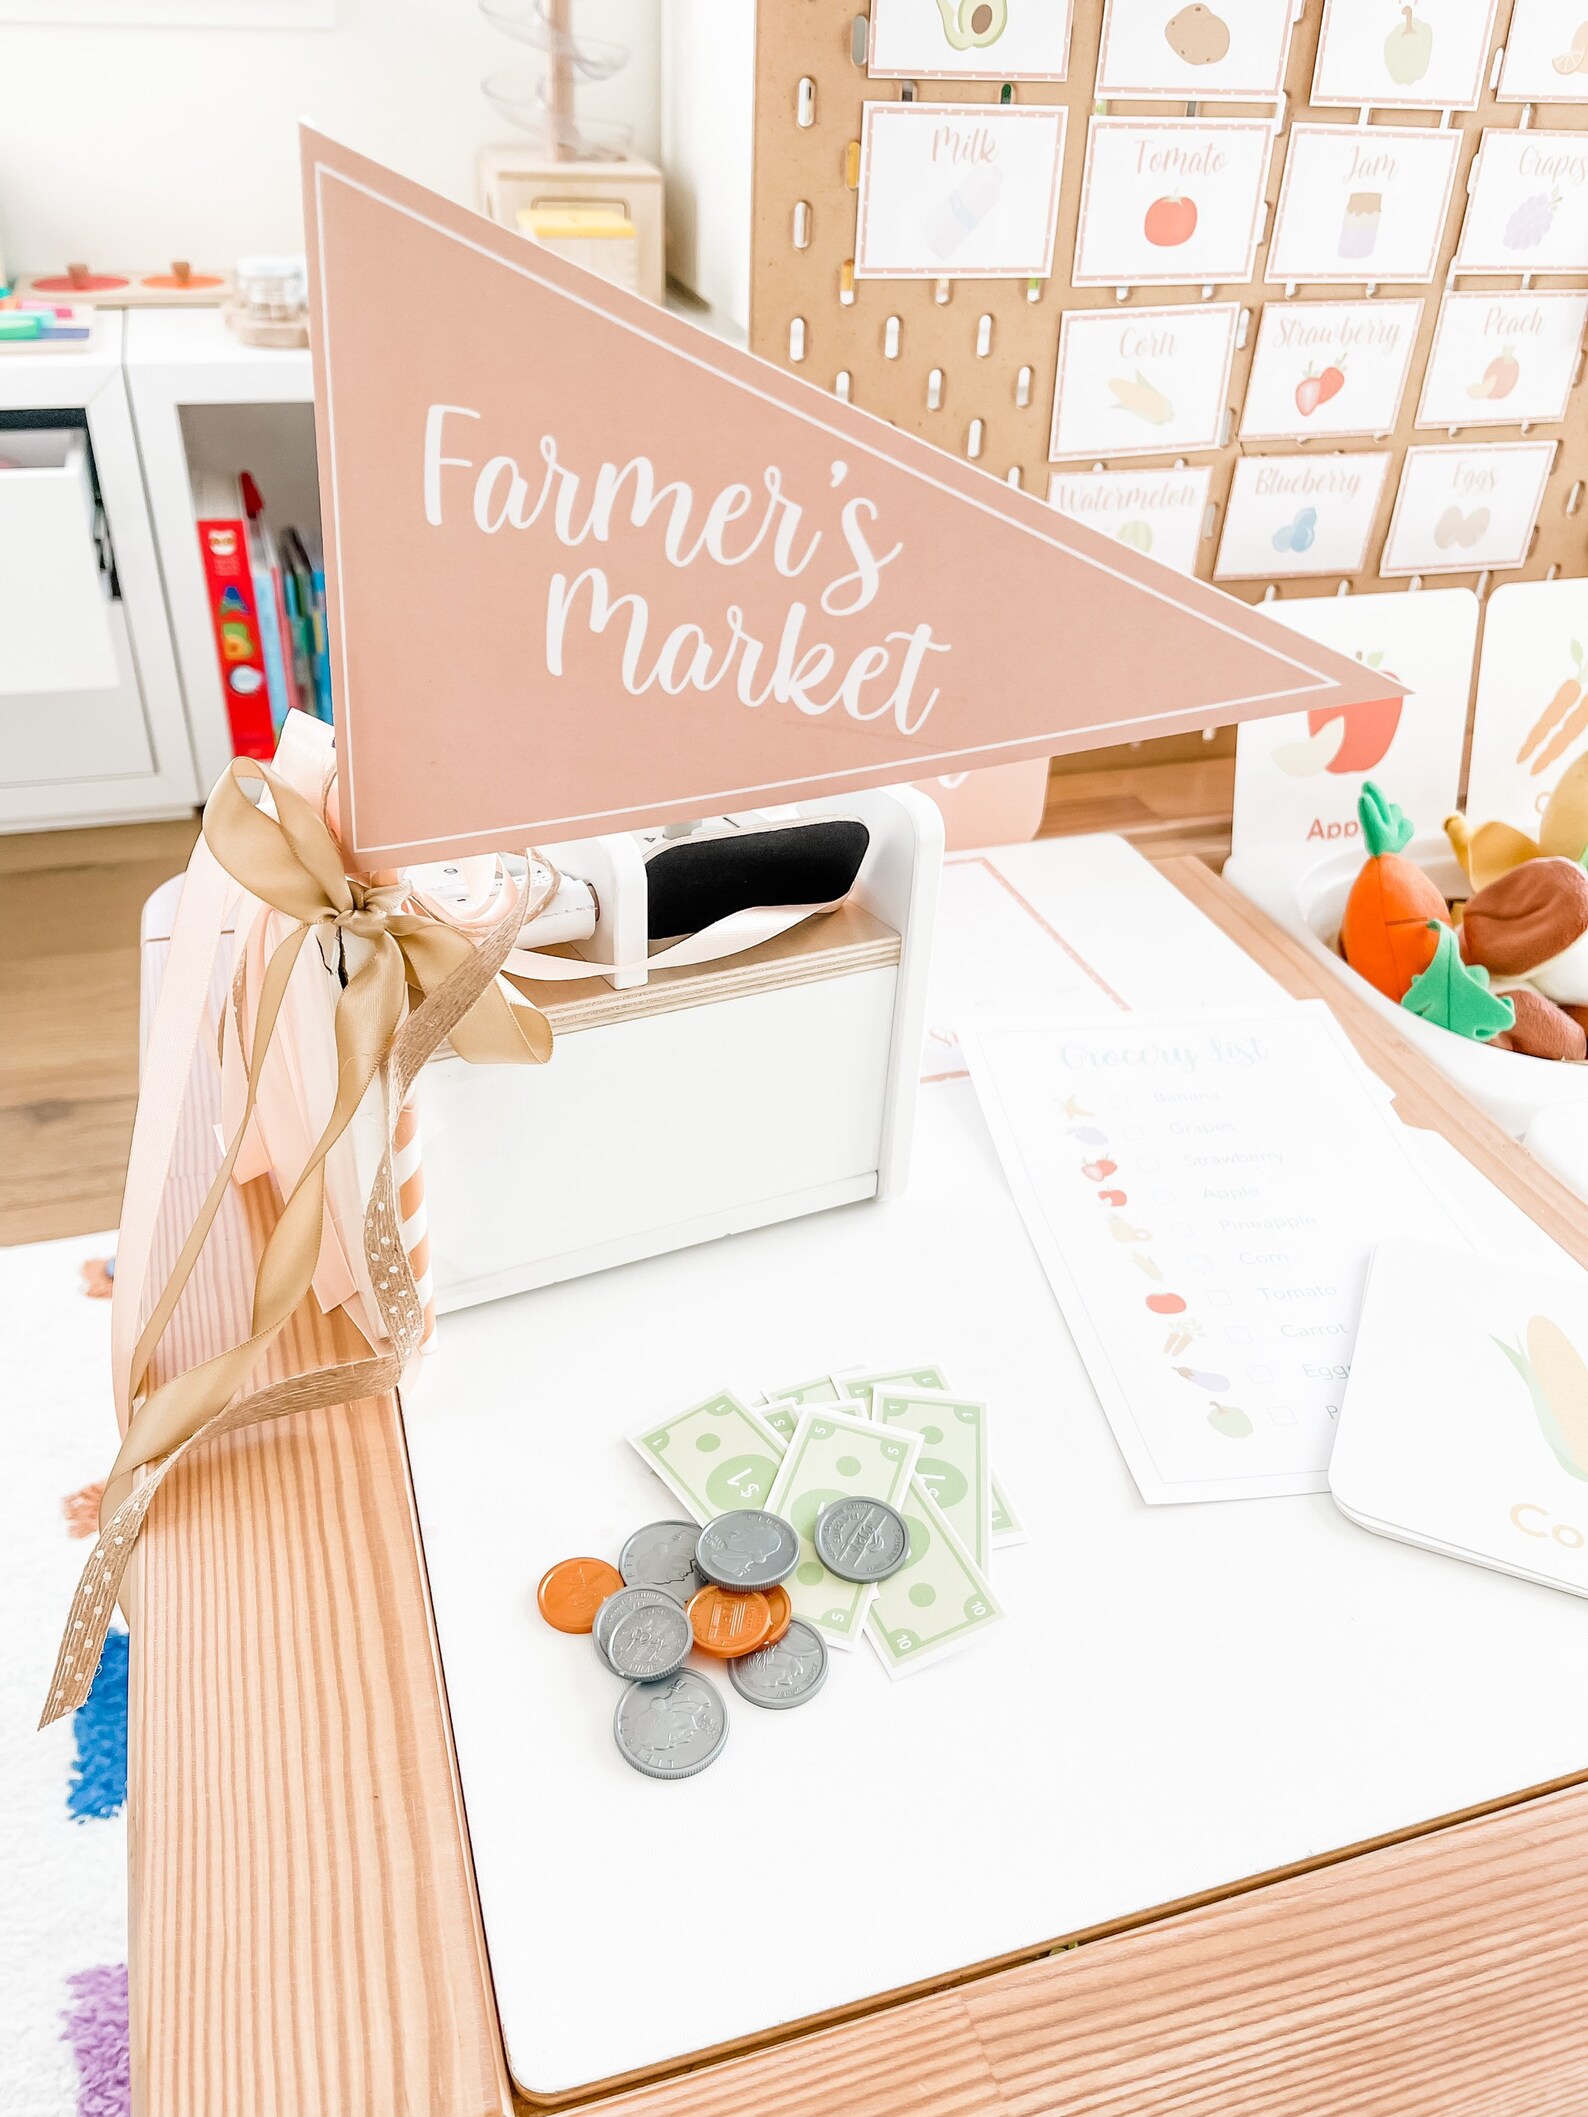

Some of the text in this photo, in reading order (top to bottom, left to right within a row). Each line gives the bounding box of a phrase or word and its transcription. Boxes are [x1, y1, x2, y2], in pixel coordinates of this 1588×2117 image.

[931, 126, 999, 165] Milk
[1134, 138, 1228, 176] Tomato
[1342, 145, 1398, 185] Jam
[1518, 144, 1588, 185] Grapes
[1272, 316, 1401, 355] Strawberry
[1482, 306, 1545, 336] Peach
[1119, 327, 1178, 360] Corn
[1254, 466, 1362, 500] Blueberry
[1452, 460, 1500, 494] Eggs
[424, 404, 902, 616] Farmer's
[1059, 483, 1196, 512] Watermelon
[546, 568, 951, 735] Market
[1306, 816, 1362, 843] App
[1060, 1036, 1269, 1073] Grocery List
[1153, 1091, 1220, 1103] Banana
[1168, 1121, 1236, 1136] Grapes
[1184, 1150, 1285, 1168] Strawberry
[1203, 1185, 1260, 1202] Apple
[1219, 1214, 1316, 1231] Pineapple
[1239, 1251, 1288, 1265] Corn
[1257, 1285, 1337, 1301] Tomato
[1280, 1323, 1350, 1338] Carrot
[1302, 1363, 1351, 1381] Egg
[1509, 1503, 1585, 1550] Co
[971, 1600, 986, 1617] 10
[896, 1634, 912, 1651] 10
